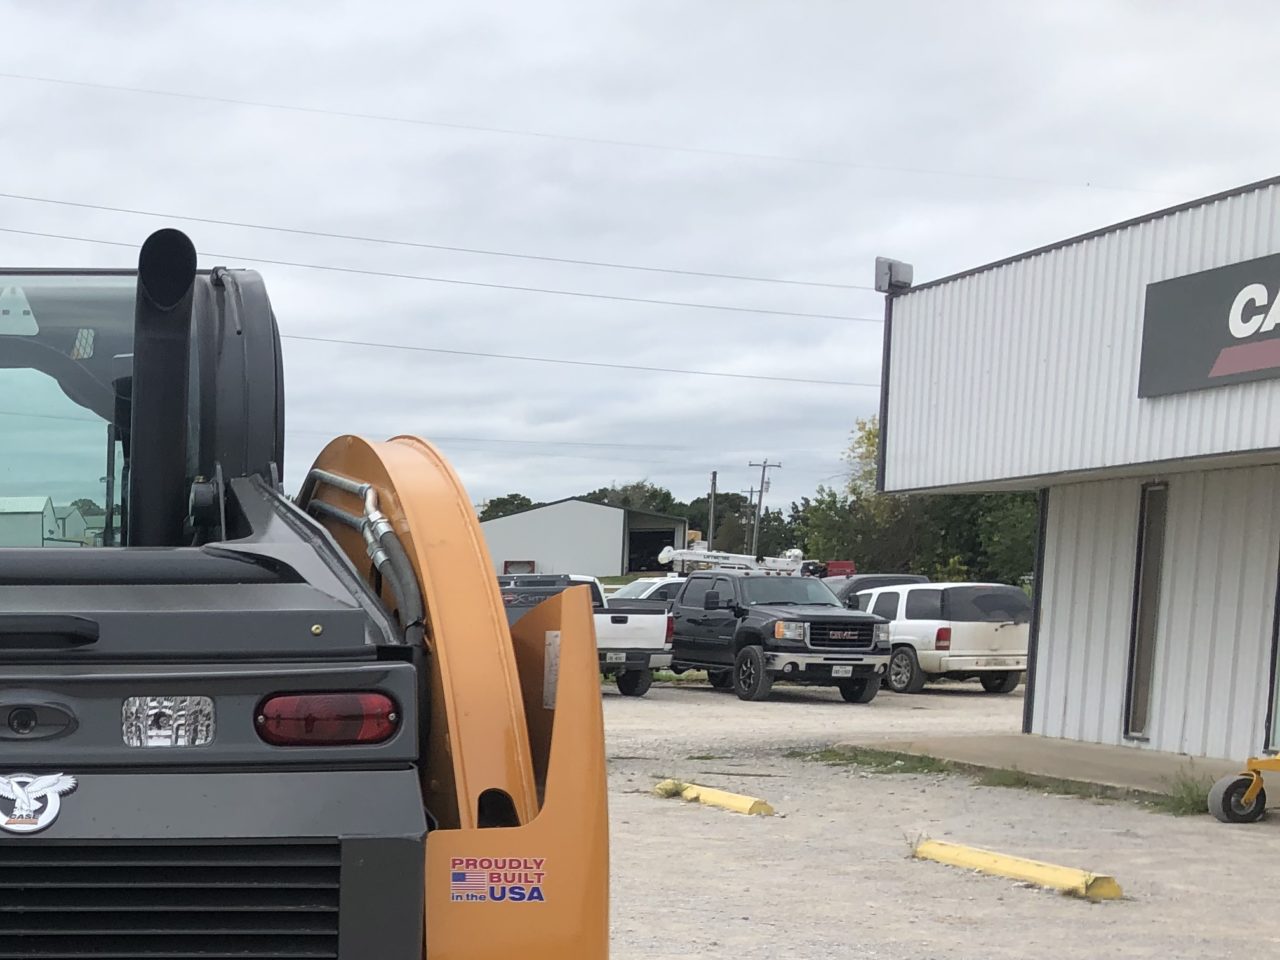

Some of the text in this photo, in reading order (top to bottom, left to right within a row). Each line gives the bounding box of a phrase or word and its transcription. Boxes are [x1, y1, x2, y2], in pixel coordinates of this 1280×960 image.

[829, 631, 859, 639] GMC
[451, 858, 545, 870] PROUDLY
[489, 872, 545, 884] BUILT
[451, 886, 545, 902] in the USA
